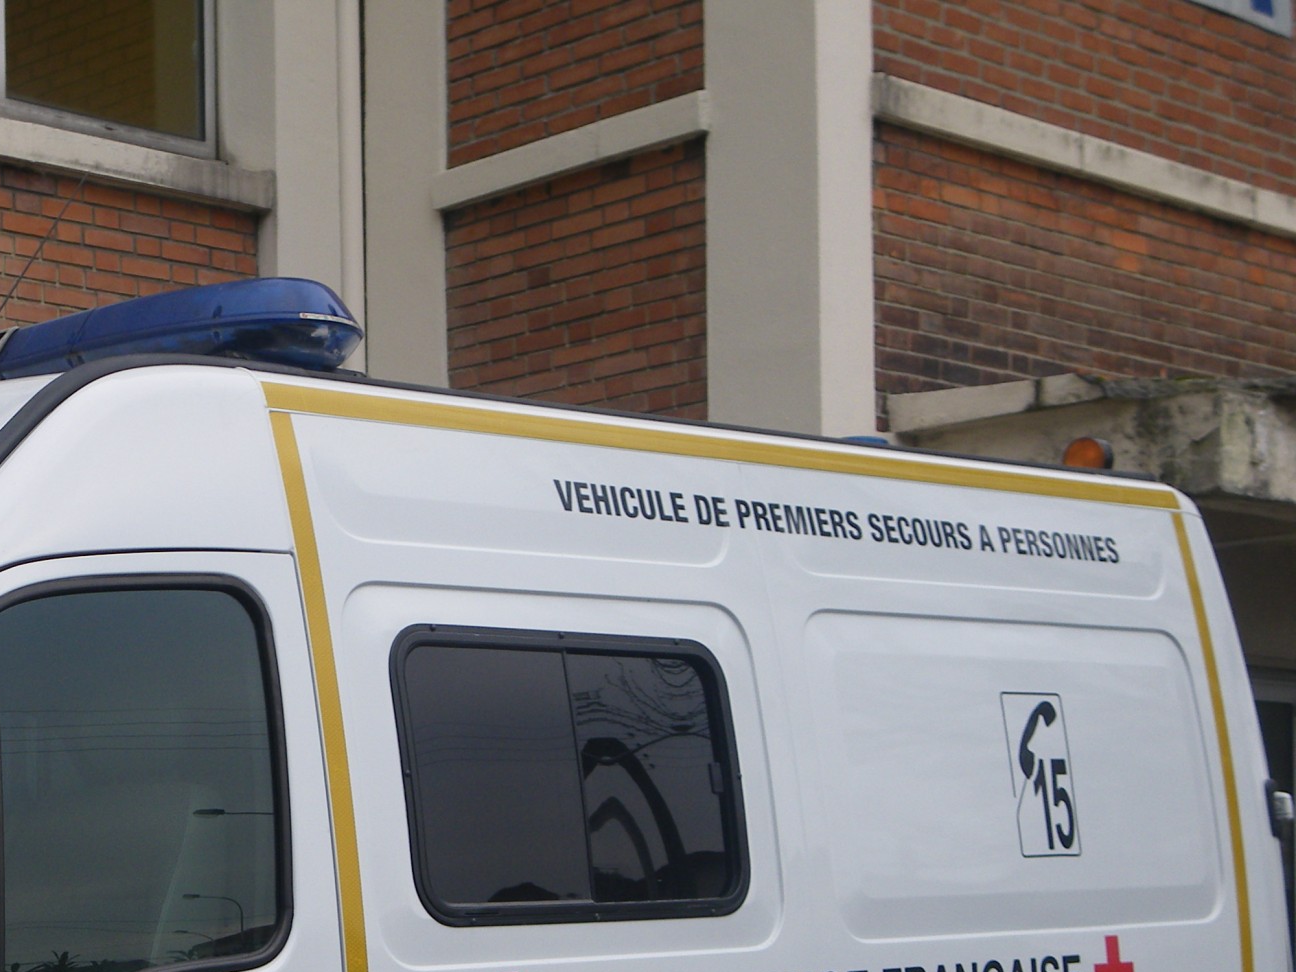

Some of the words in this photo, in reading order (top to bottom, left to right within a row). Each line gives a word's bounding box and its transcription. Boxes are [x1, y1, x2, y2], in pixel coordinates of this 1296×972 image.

[554, 479, 688, 524] VEHICULE
[694, 494, 730, 528] DE
[736, 499, 864, 542] PREMIERS
[868, 513, 973, 551] SECOURS
[979, 524, 996, 554] A
[998, 526, 1121, 564] PERSONNES
[1033, 758, 1075, 850] 15
